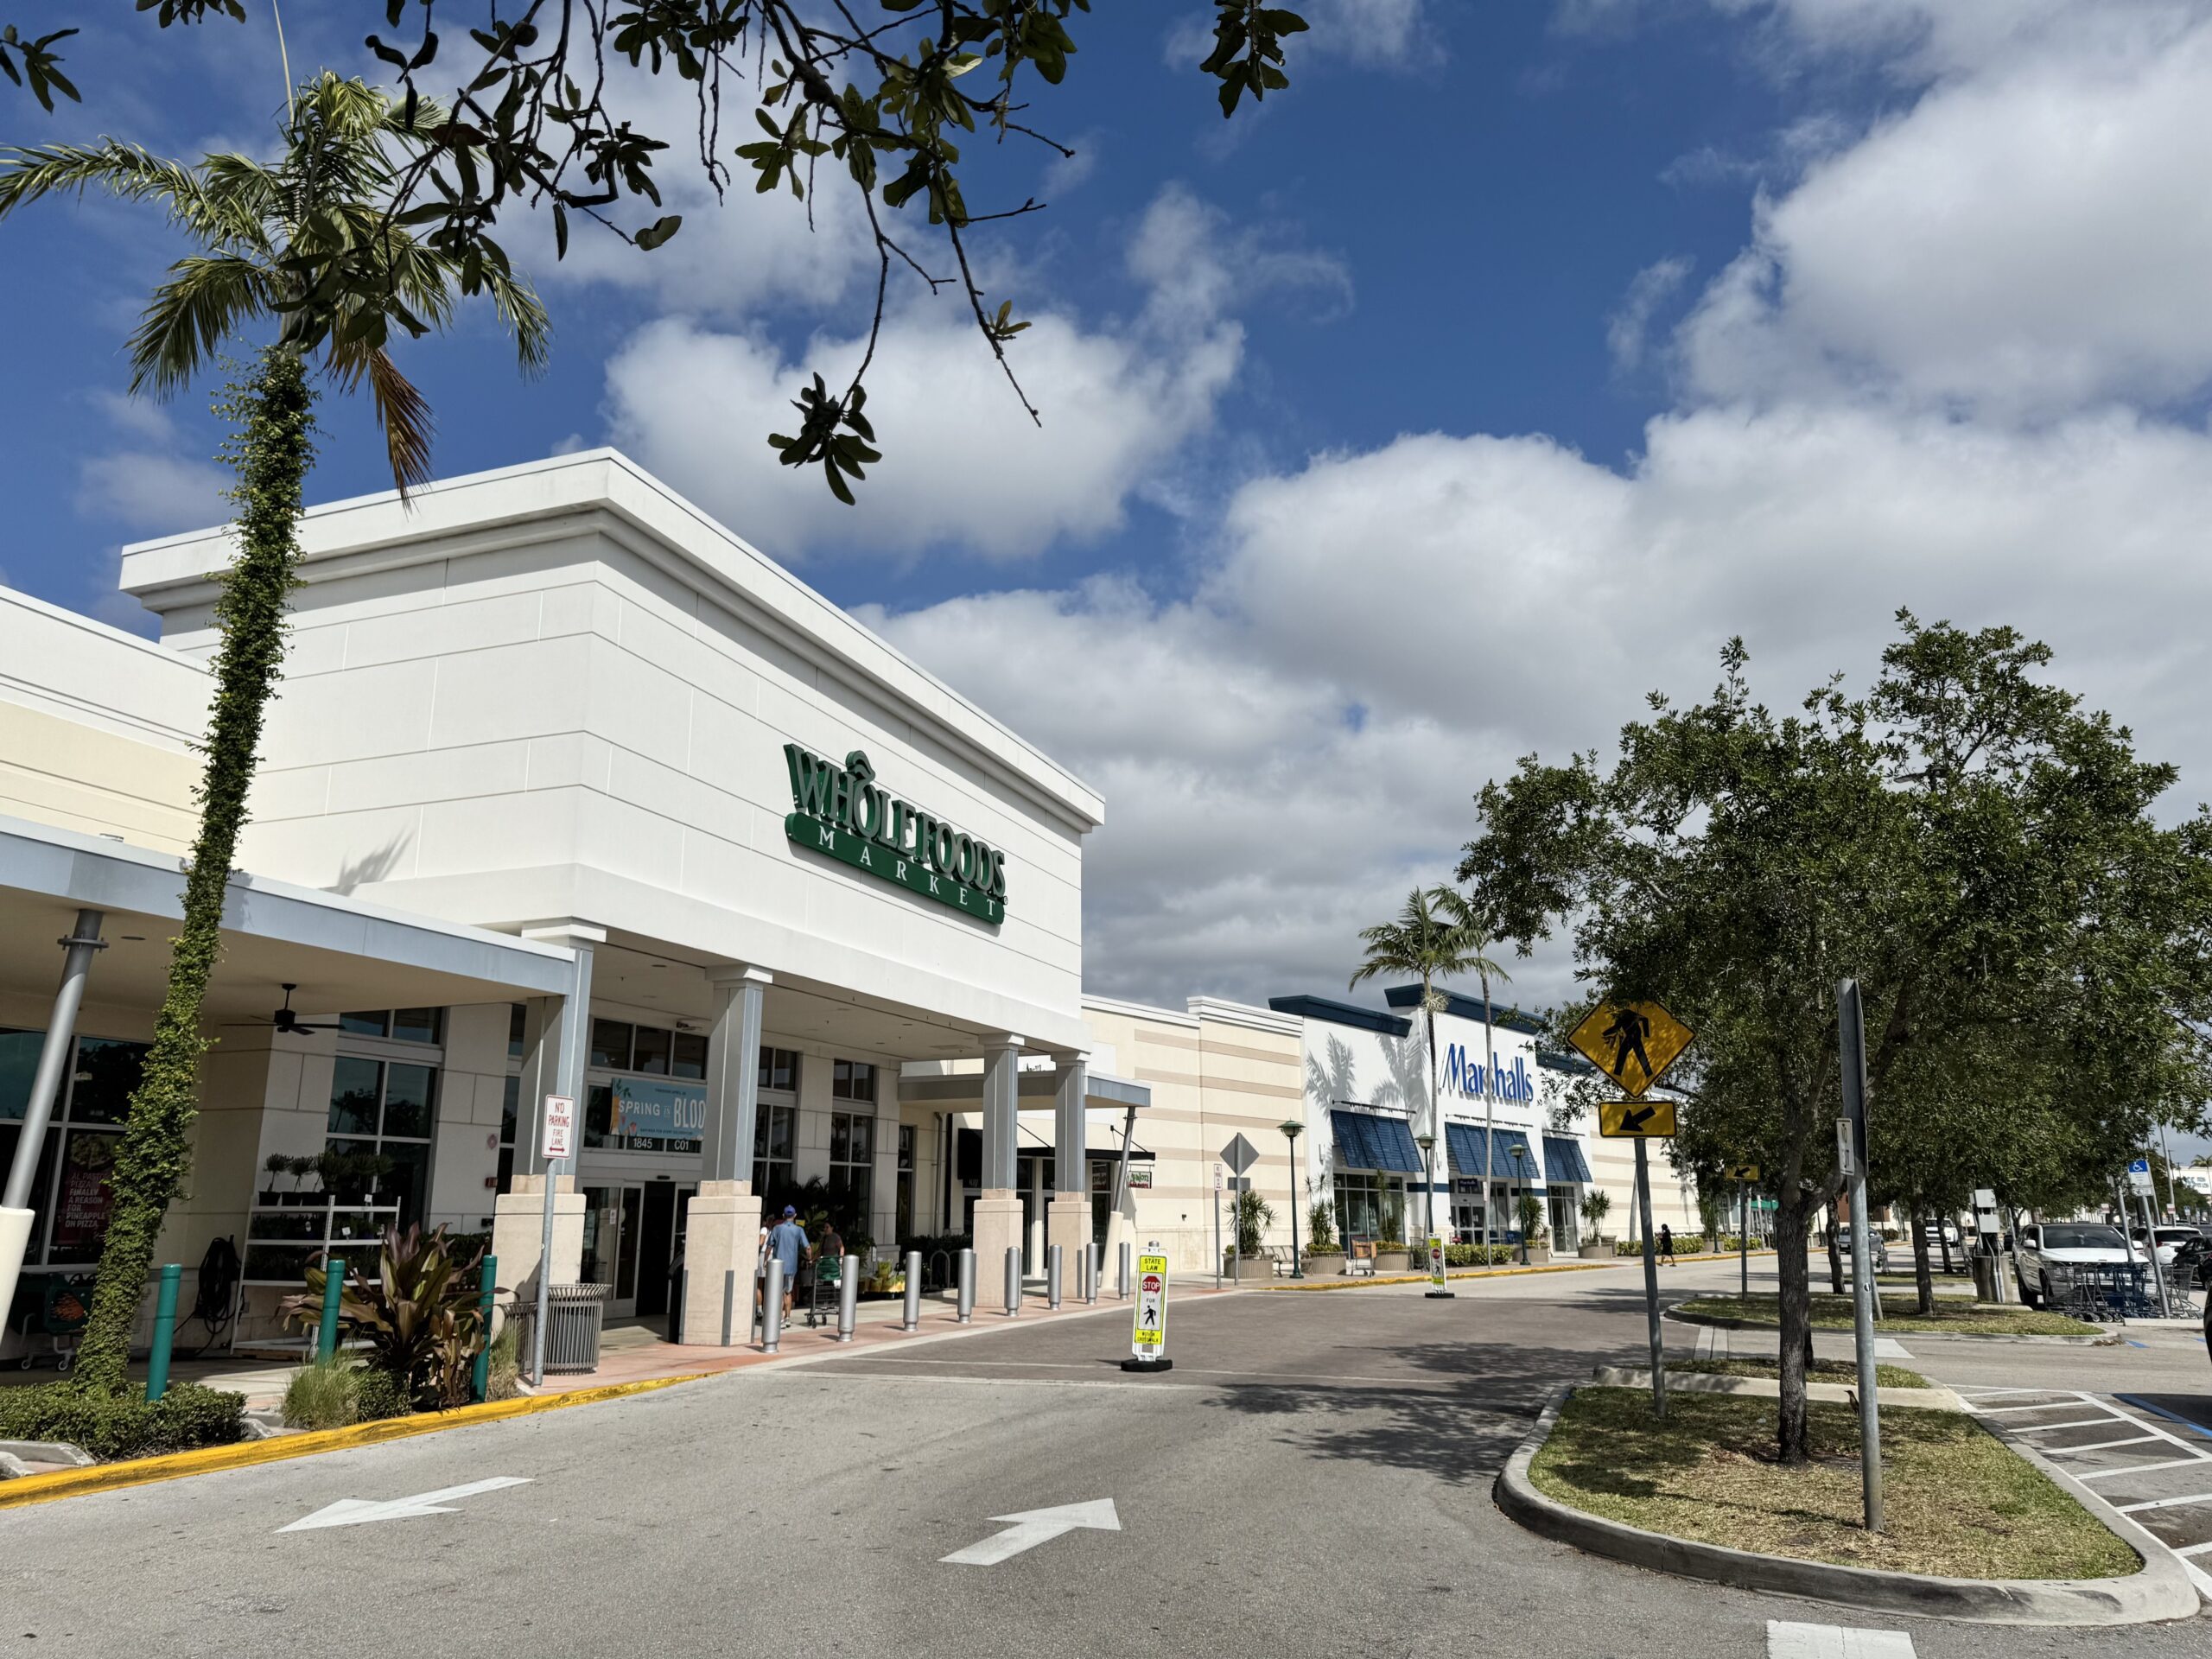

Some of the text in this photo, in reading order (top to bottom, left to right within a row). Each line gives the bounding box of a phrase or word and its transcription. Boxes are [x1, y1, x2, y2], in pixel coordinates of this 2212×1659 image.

[784, 744, 1006, 899] WHOLE FOODS
[819, 825, 995, 916] MARKET
[555, 1102, 565, 1114] NO
[618, 1100, 661, 1116] SPRING
[674, 1097, 707, 1129] BLOO
[548, 1115, 570, 1128] PARKING
[553, 1128, 563, 1137] FIRE
[551, 1137, 563, 1146] LANE
[633, 1138, 653, 1149] 1845
[674, 1140, 690, 1151] C01
[1142, 1281, 1160, 1290] STOP
